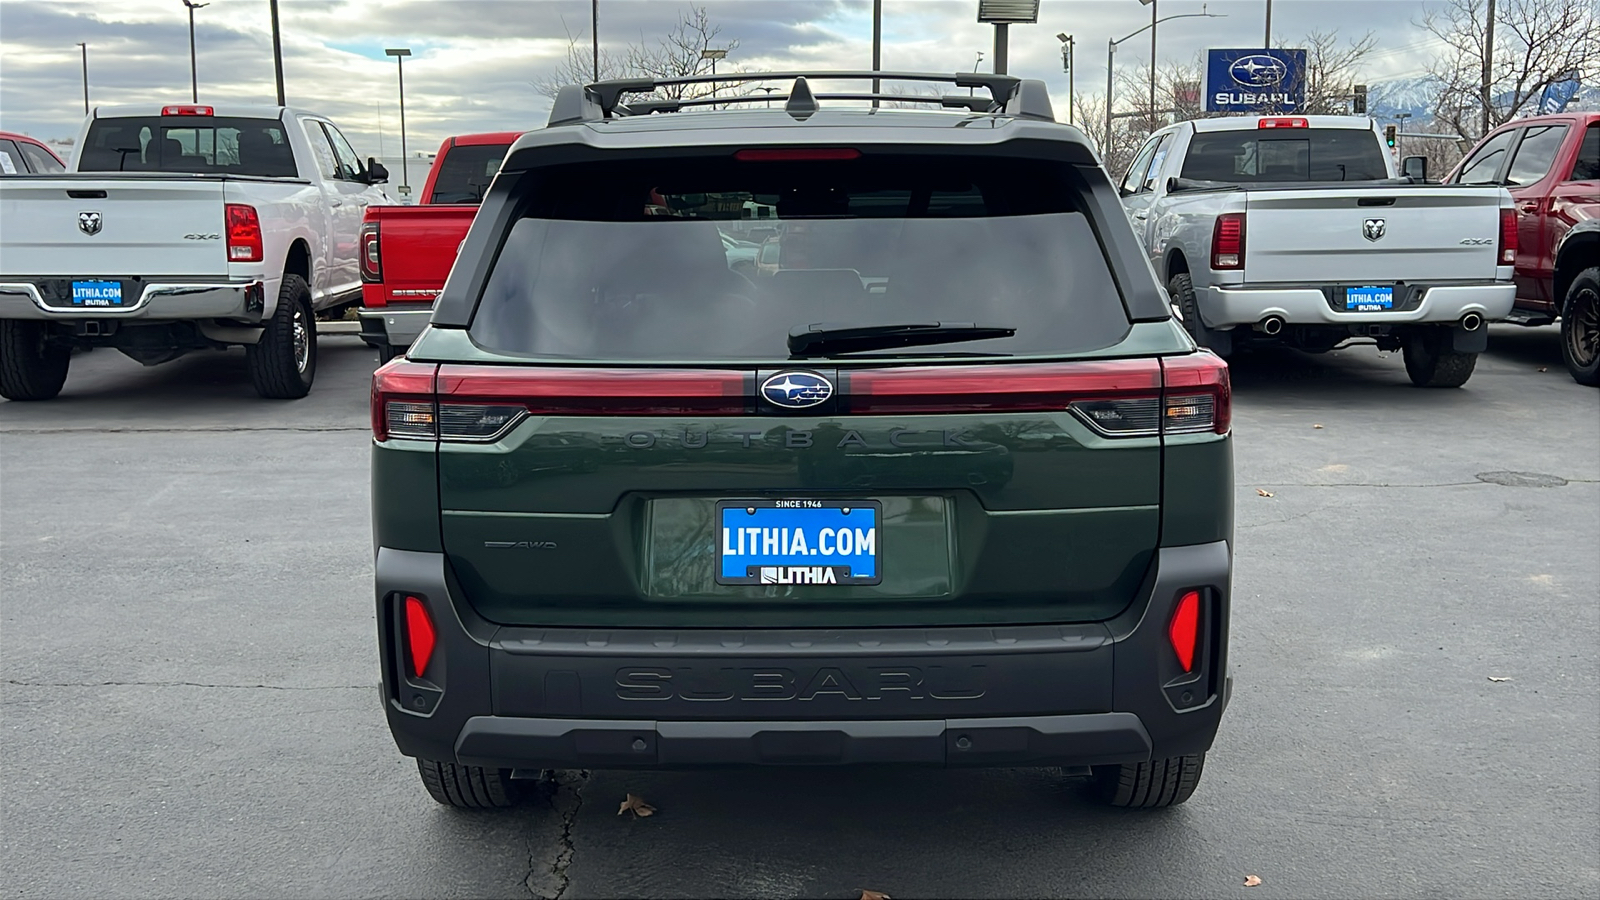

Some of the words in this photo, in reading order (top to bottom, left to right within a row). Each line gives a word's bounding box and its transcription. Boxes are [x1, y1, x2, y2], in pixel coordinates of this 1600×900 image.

[73, 288, 121, 298] LITHIA.COM
[1347, 293, 1392, 303] LITHIA.COM
[623, 430, 970, 449] OUTBACK
[775, 500, 801, 508] SINCE
[802, 500, 822, 508] 1946
[723, 527, 875, 556] LITHIA.COM
[778, 567, 837, 584] LITHIA
[615, 666, 986, 701] SUBARU
